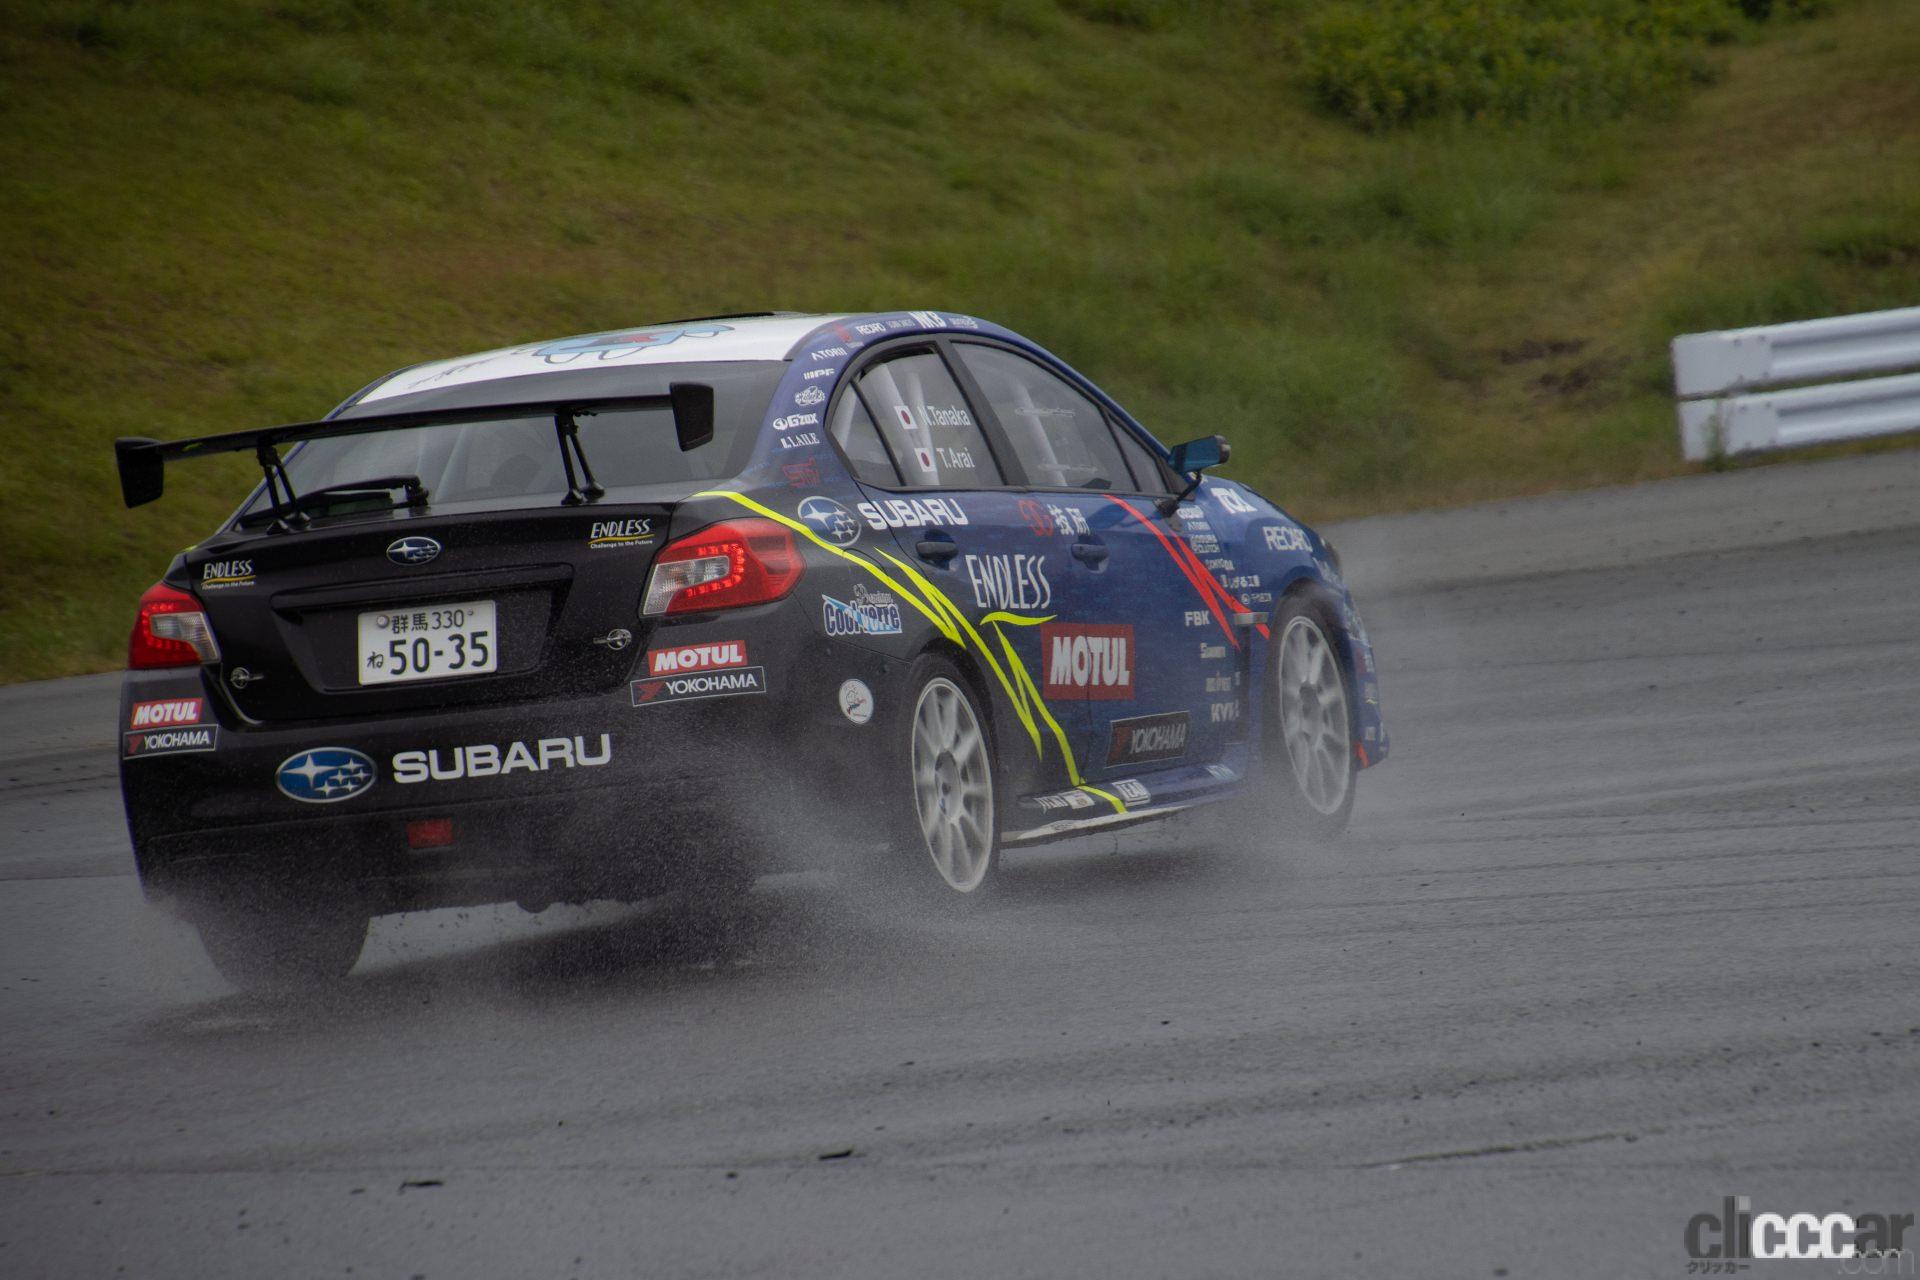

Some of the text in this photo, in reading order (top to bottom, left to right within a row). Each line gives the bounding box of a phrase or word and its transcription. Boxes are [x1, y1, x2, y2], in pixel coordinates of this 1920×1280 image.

[858, 498, 969, 531] SUBARU
[590, 518, 652, 539] ENDLESS
[203, 559, 253, 580] ENDLESS
[965, 553, 1052, 609] ENDLESS
[391, 608, 466, 633] 群馬 330
[1184, 610, 1210, 628] FBK
[366, 630, 490, 675] ね 50-35
[654, 644, 743, 673] MOTUL
[1050, 636, 1130, 687] MOTUL
[666, 674, 758, 696] YOKOHAMA
[133, 701, 198, 725] MOTUL
[143, 730, 210, 750] YOKOHAMA
[1130, 723, 1187, 755] YOKOHAMA
[392, 734, 612, 784] SUBARU
